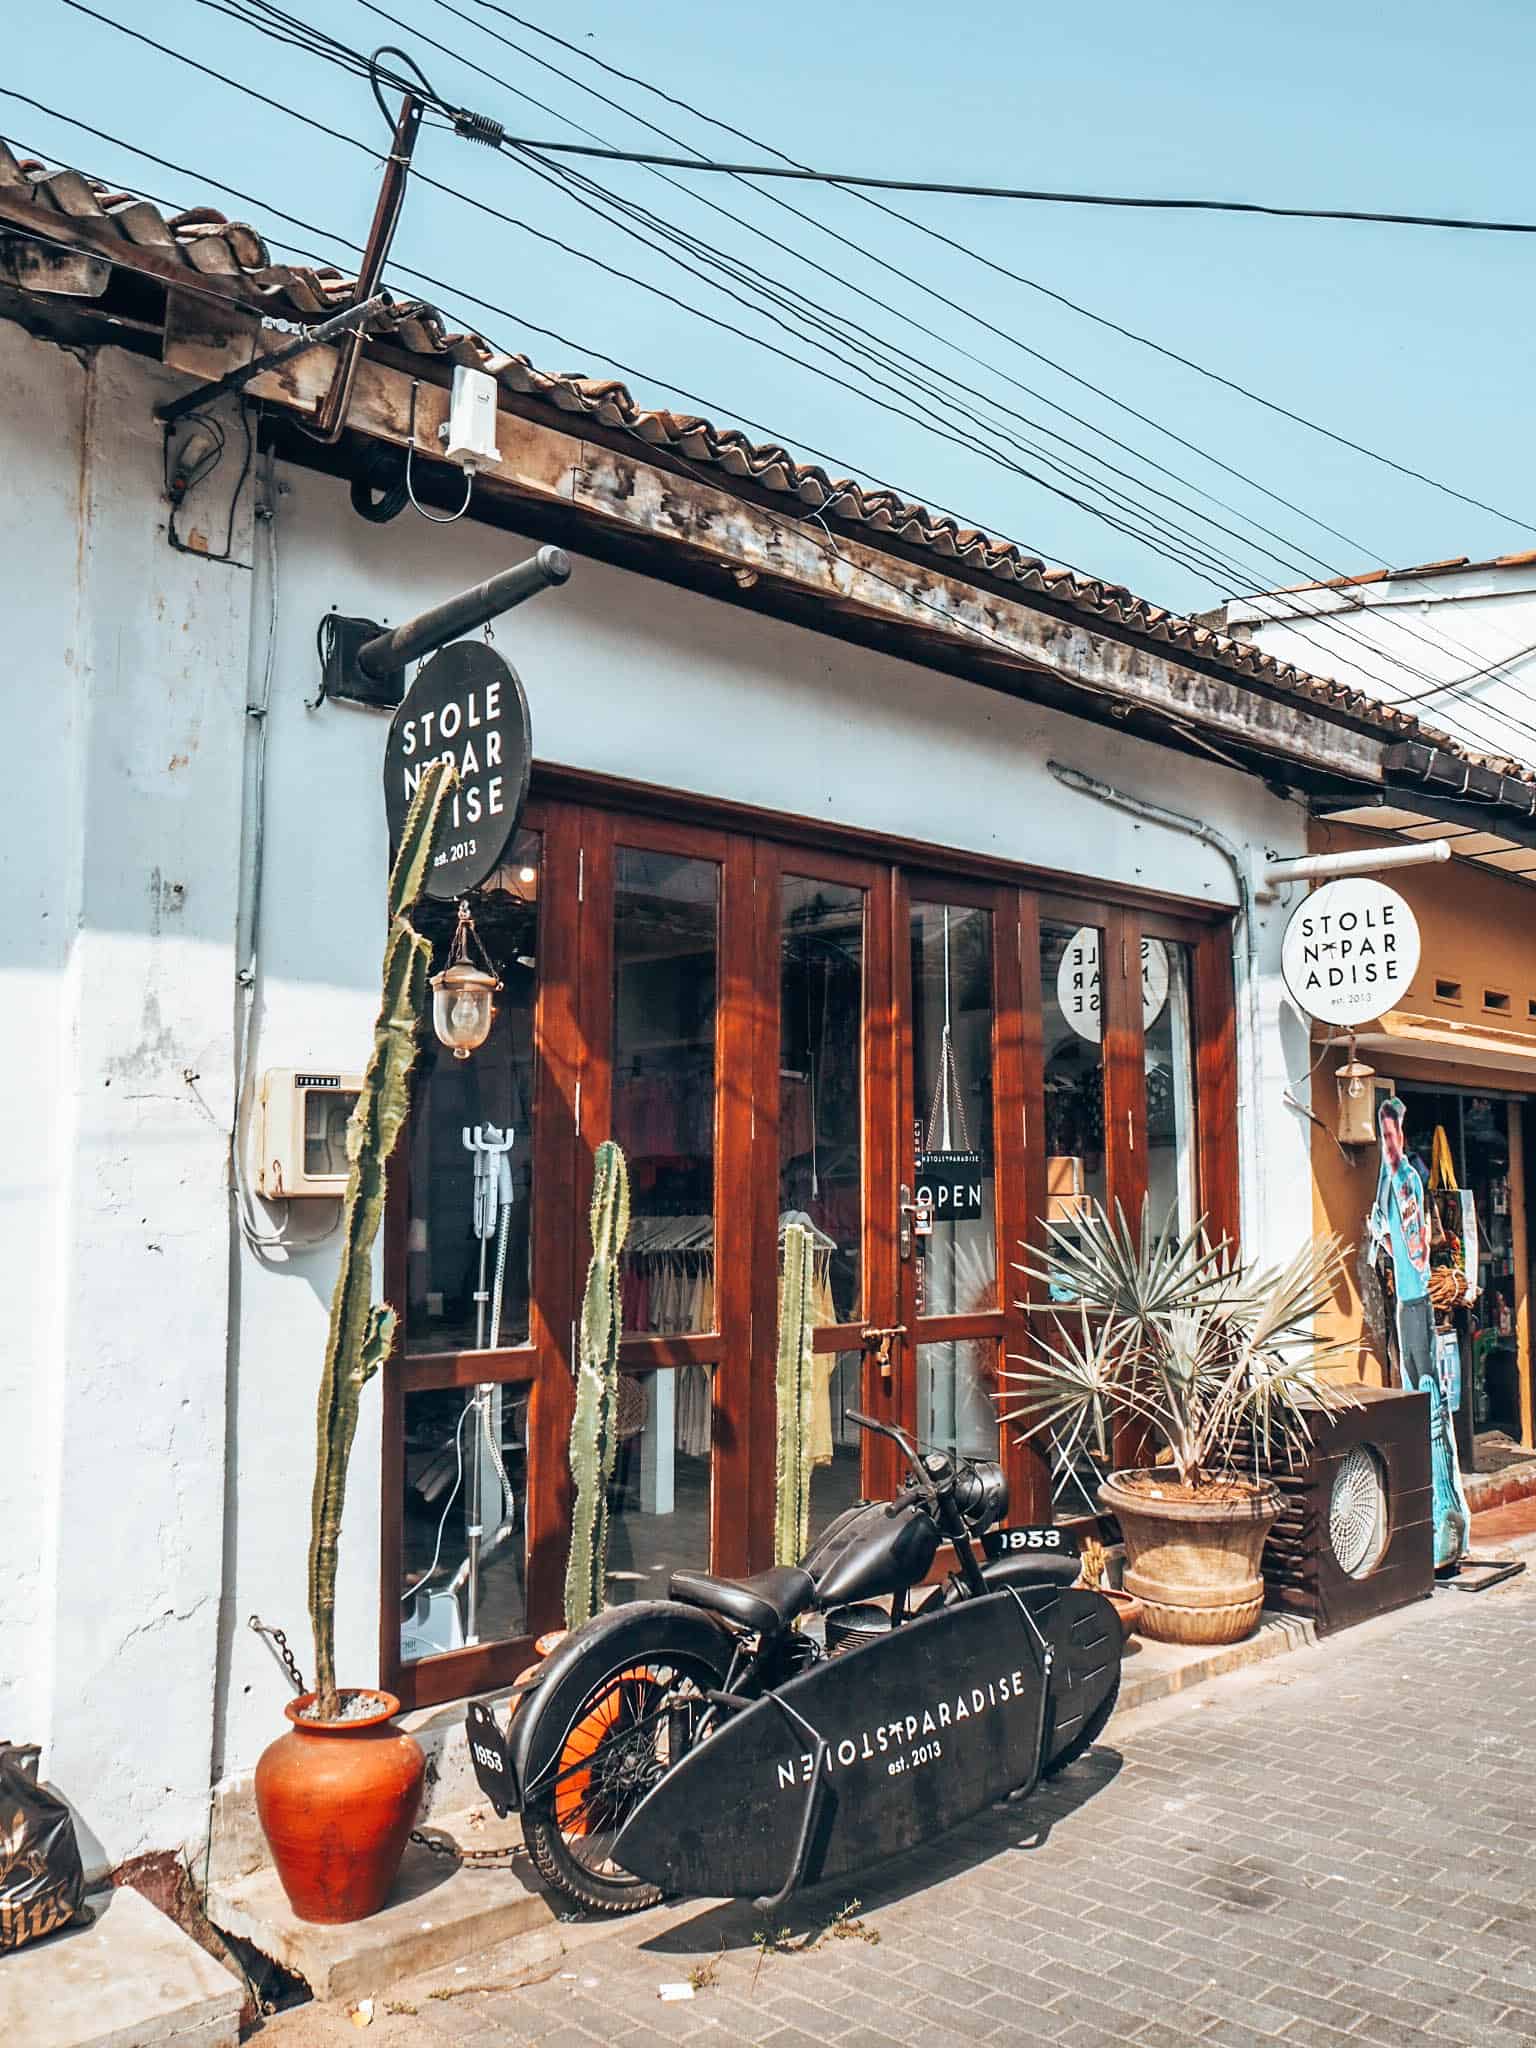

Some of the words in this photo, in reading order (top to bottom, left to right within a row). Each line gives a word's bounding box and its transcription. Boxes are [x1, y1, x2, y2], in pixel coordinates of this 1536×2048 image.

[402, 681, 501, 756] STOLE
[452, 776, 504, 828] ISE
[433, 851, 449, 867] est.
[450, 839, 476, 862] 2013
[1303, 905, 1395, 937] STOLE
[1305, 960, 1398, 990] ADISE
[917, 1184, 982, 1209] OPEN
[1000, 1530, 1060, 1549] 1953
[906, 1670, 1025, 1741] PARADISE
[887, 1754, 910, 1776] est.
[911, 1740, 942, 1767] 2013
